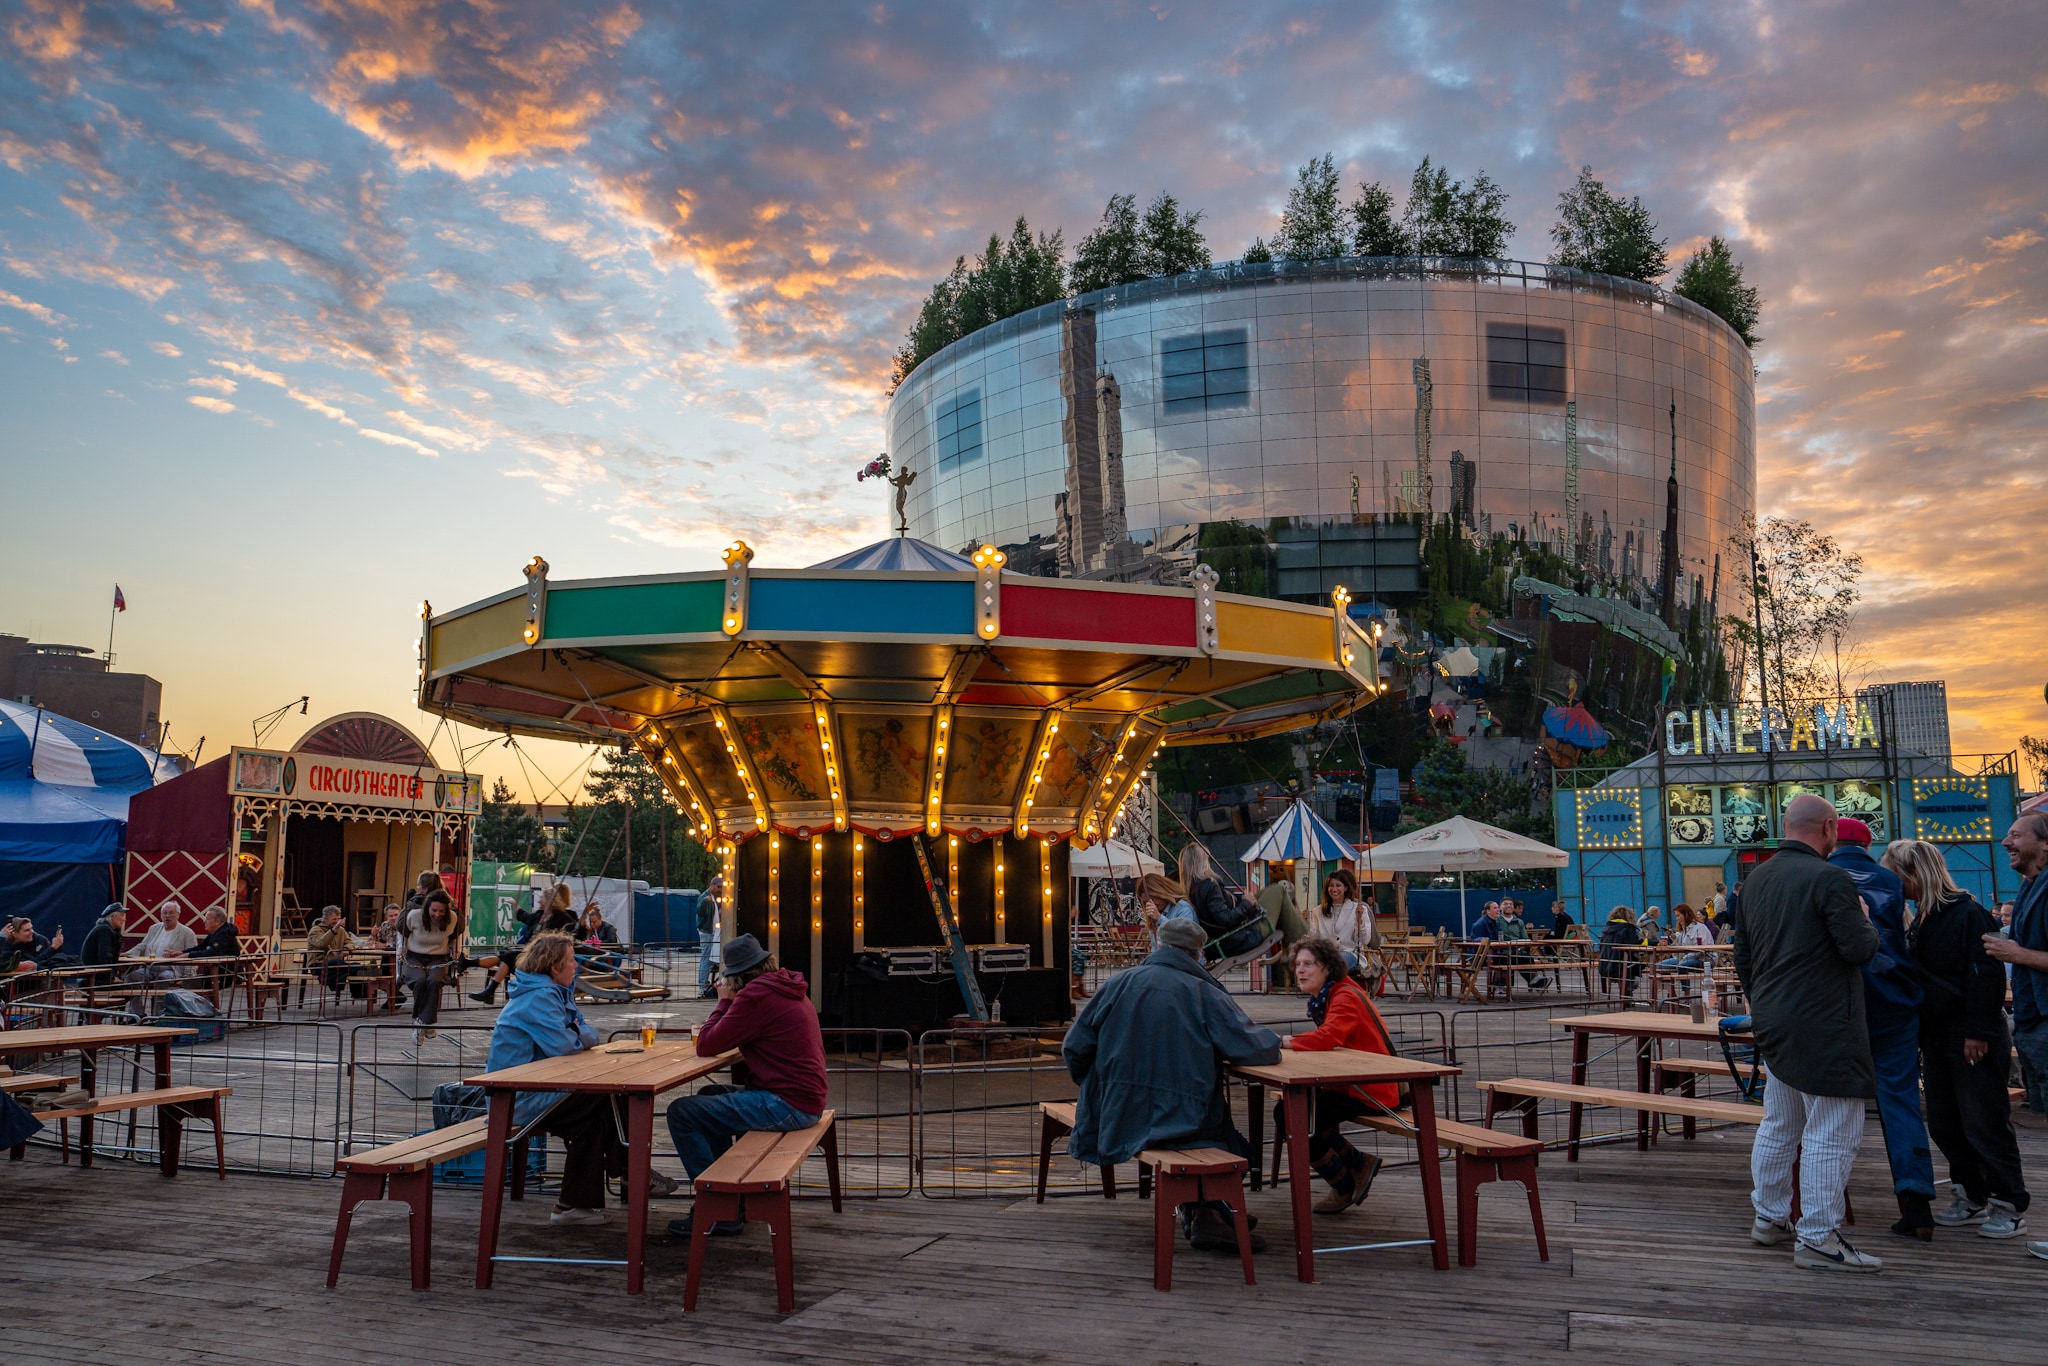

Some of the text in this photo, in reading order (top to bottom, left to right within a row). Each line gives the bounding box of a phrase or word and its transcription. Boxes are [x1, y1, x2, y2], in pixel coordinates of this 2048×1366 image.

[1665, 702, 1881, 756] CINERAMA
[309, 765, 423, 800] CIRCUSTHEATER
[1580, 792, 1637, 811] ELECTRIC
[1586, 814, 1633, 823] PICTURE
[1924, 817, 1985, 835] THEATRE
[1584, 825, 1636, 844] PALACE
